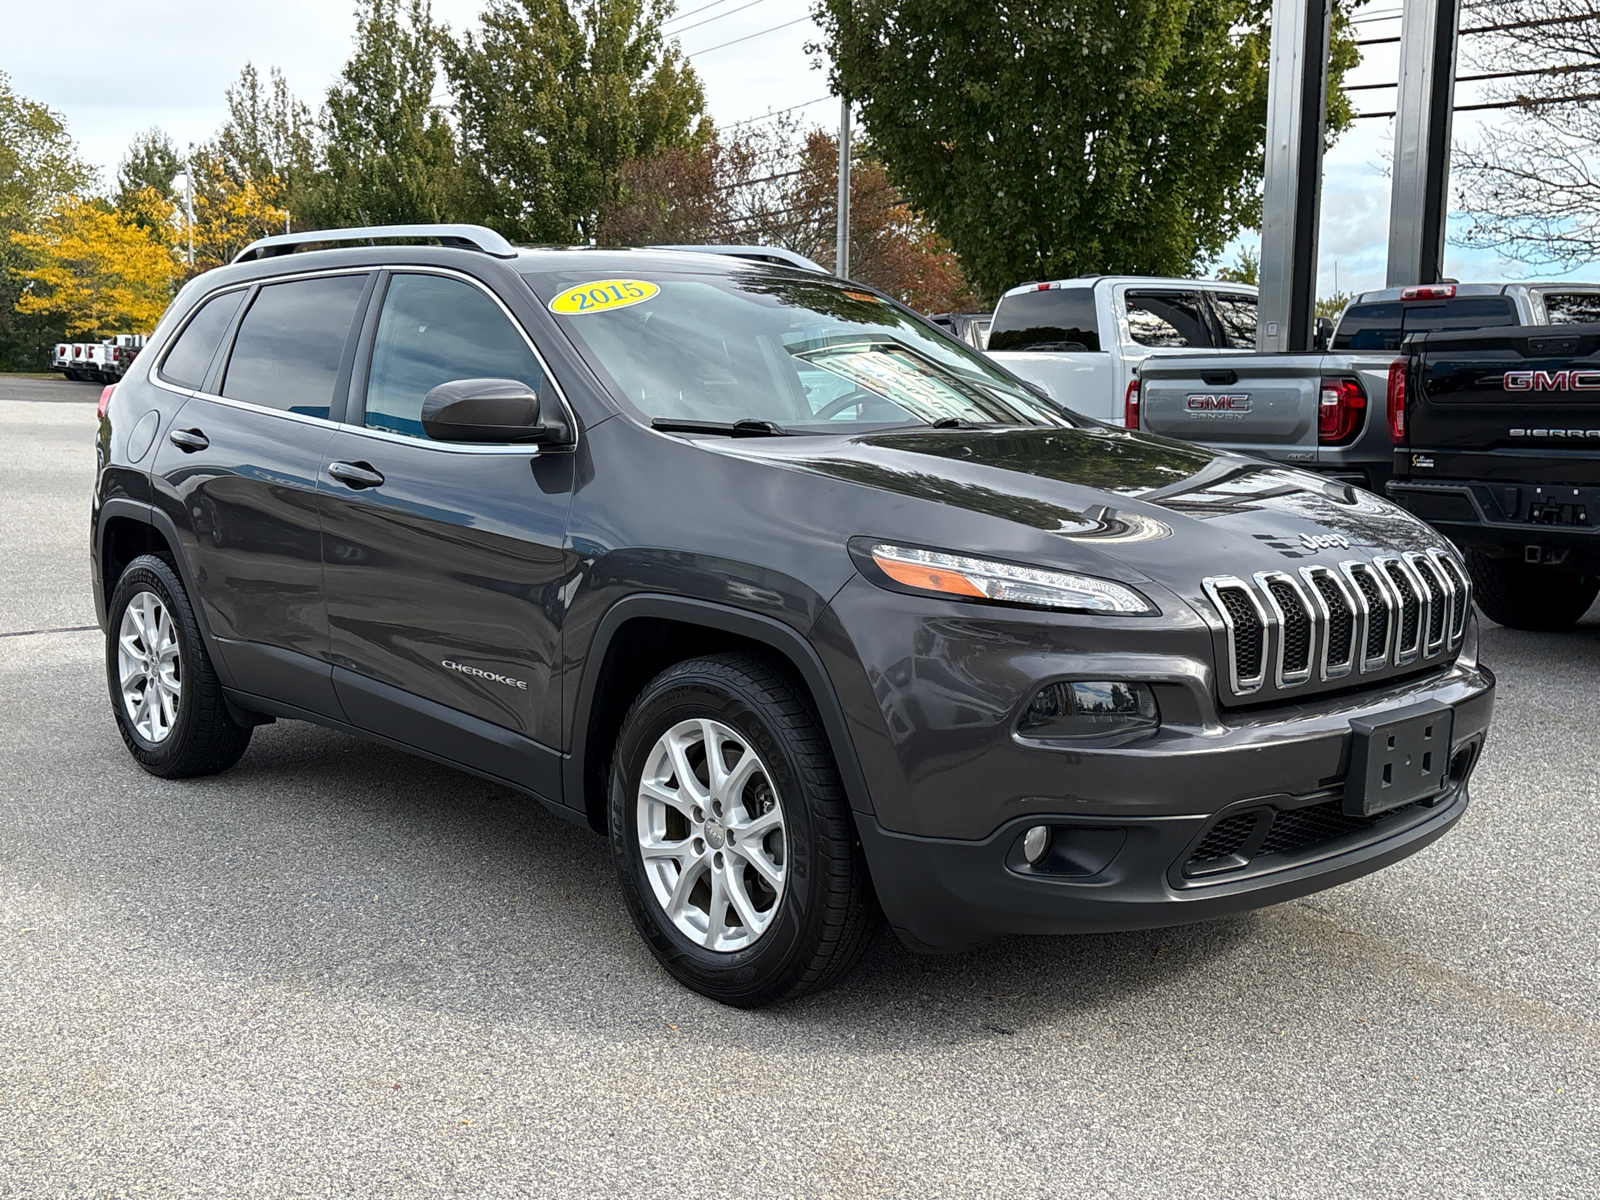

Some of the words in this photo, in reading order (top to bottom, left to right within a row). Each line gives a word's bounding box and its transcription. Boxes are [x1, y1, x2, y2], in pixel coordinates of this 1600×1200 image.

[570, 282, 644, 311] 2015
[1502, 370, 1600, 392] GMC
[1187, 394, 1250, 410] GMC
[1509, 428, 1600, 438] SIERRA
[1298, 532, 1350, 551] Jeep
[441, 659, 529, 691] CHEROKEE
